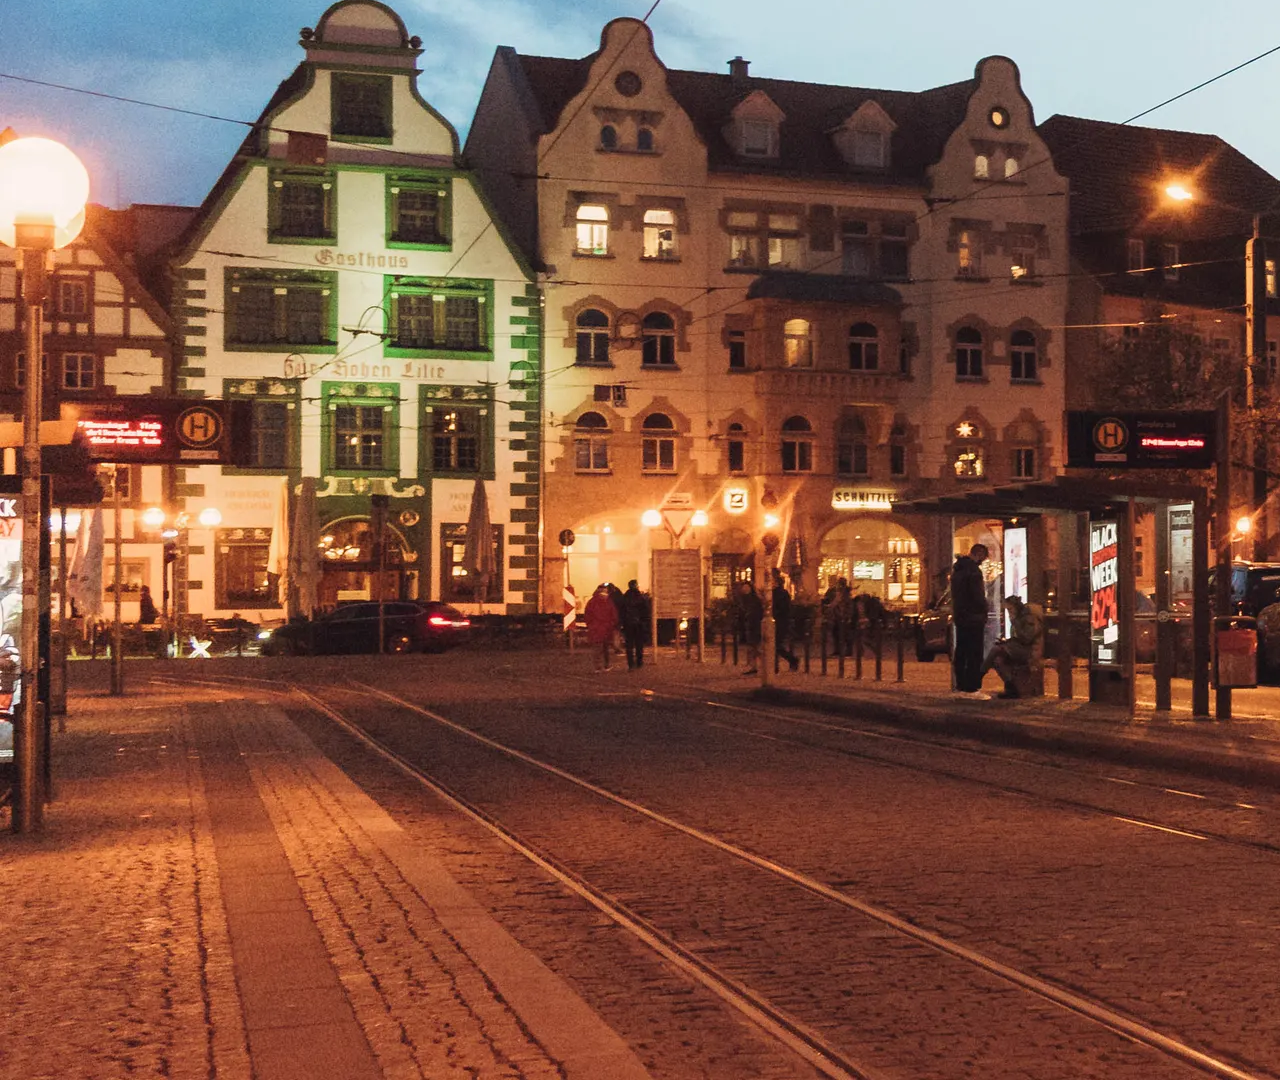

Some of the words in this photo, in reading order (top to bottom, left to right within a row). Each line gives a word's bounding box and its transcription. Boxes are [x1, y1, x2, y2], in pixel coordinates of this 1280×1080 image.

[315, 248, 409, 269] Gasthaus
[331, 359, 392, 379] Hohen
[401, 361, 446, 379] Lilie
[190, 416, 209, 437] H
[1103, 424, 1118, 445] H
[1092, 523, 1118, 553] BLACK
[1092, 557, 1118, 592] WEEK
